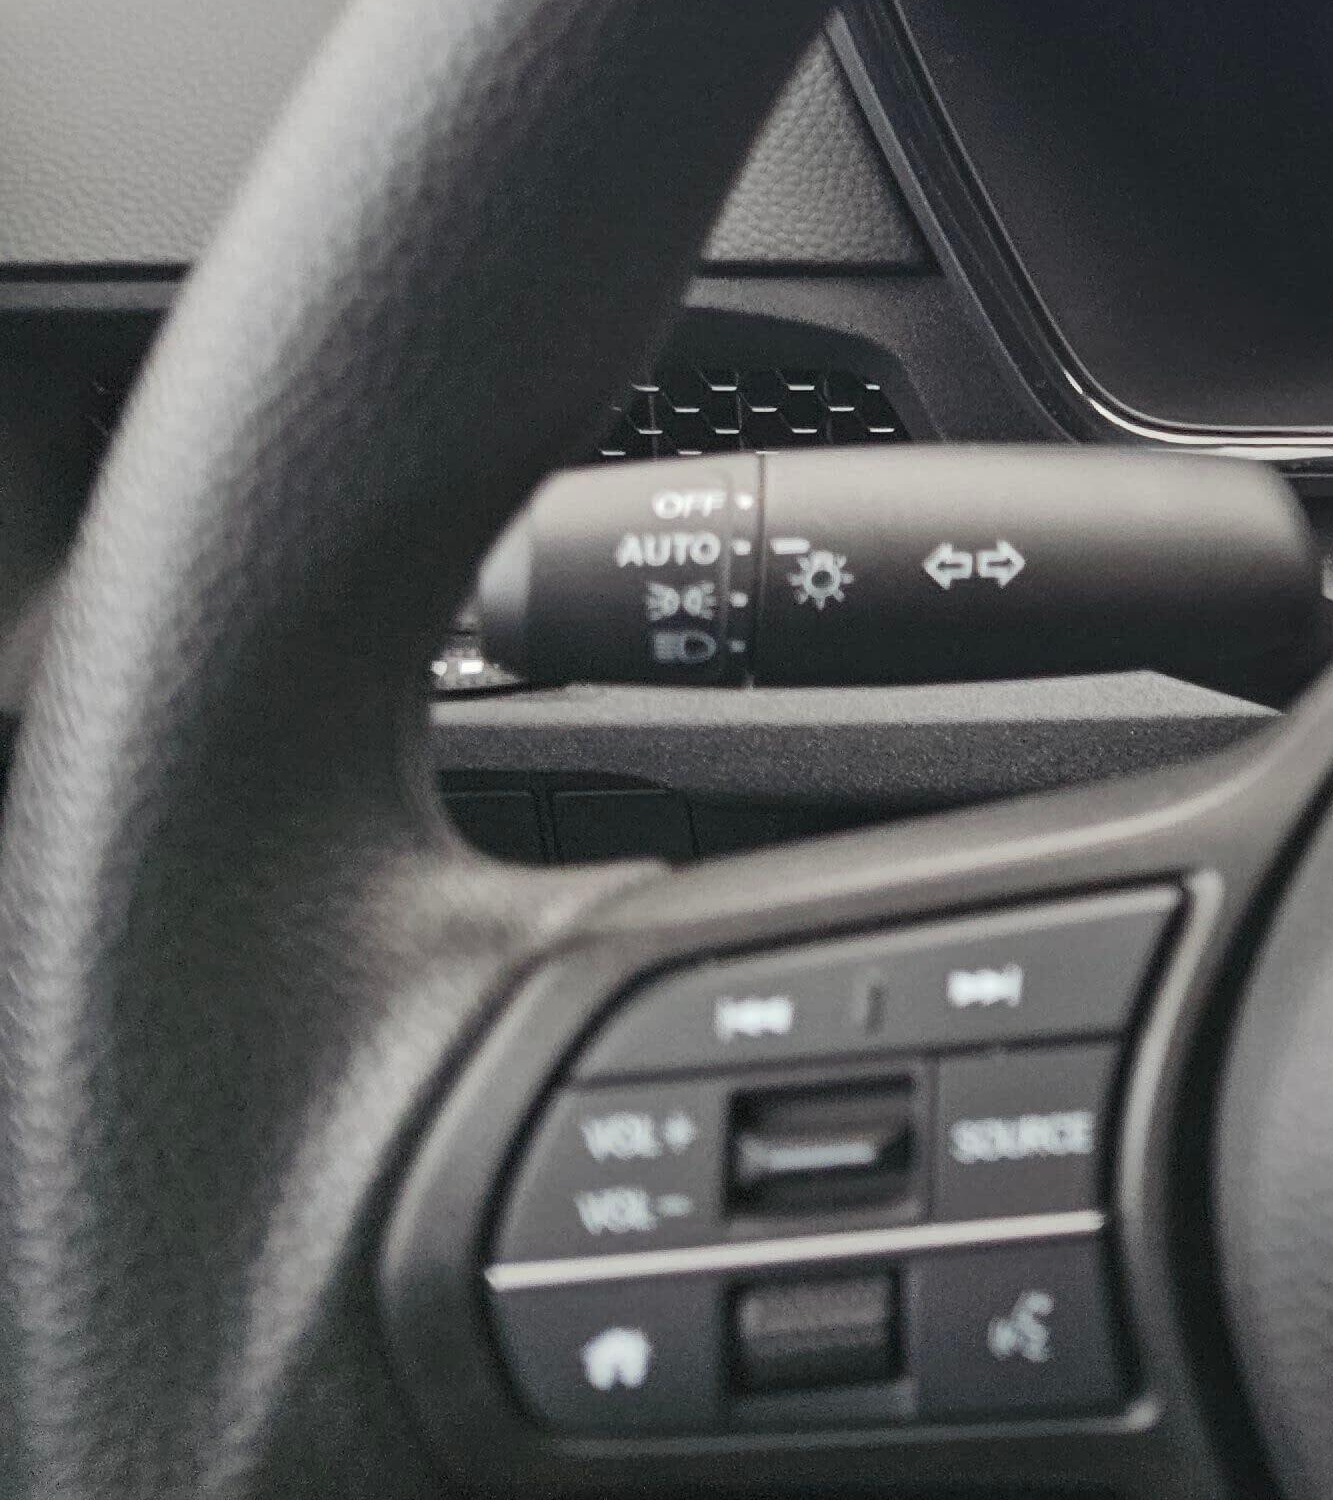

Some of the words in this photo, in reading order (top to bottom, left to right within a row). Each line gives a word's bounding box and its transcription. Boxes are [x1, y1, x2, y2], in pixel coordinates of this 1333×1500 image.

[653, 492, 727, 518] OFF
[616, 532, 722, 568] AUTO
[951, 1110, 1095, 1163] SOURCE
